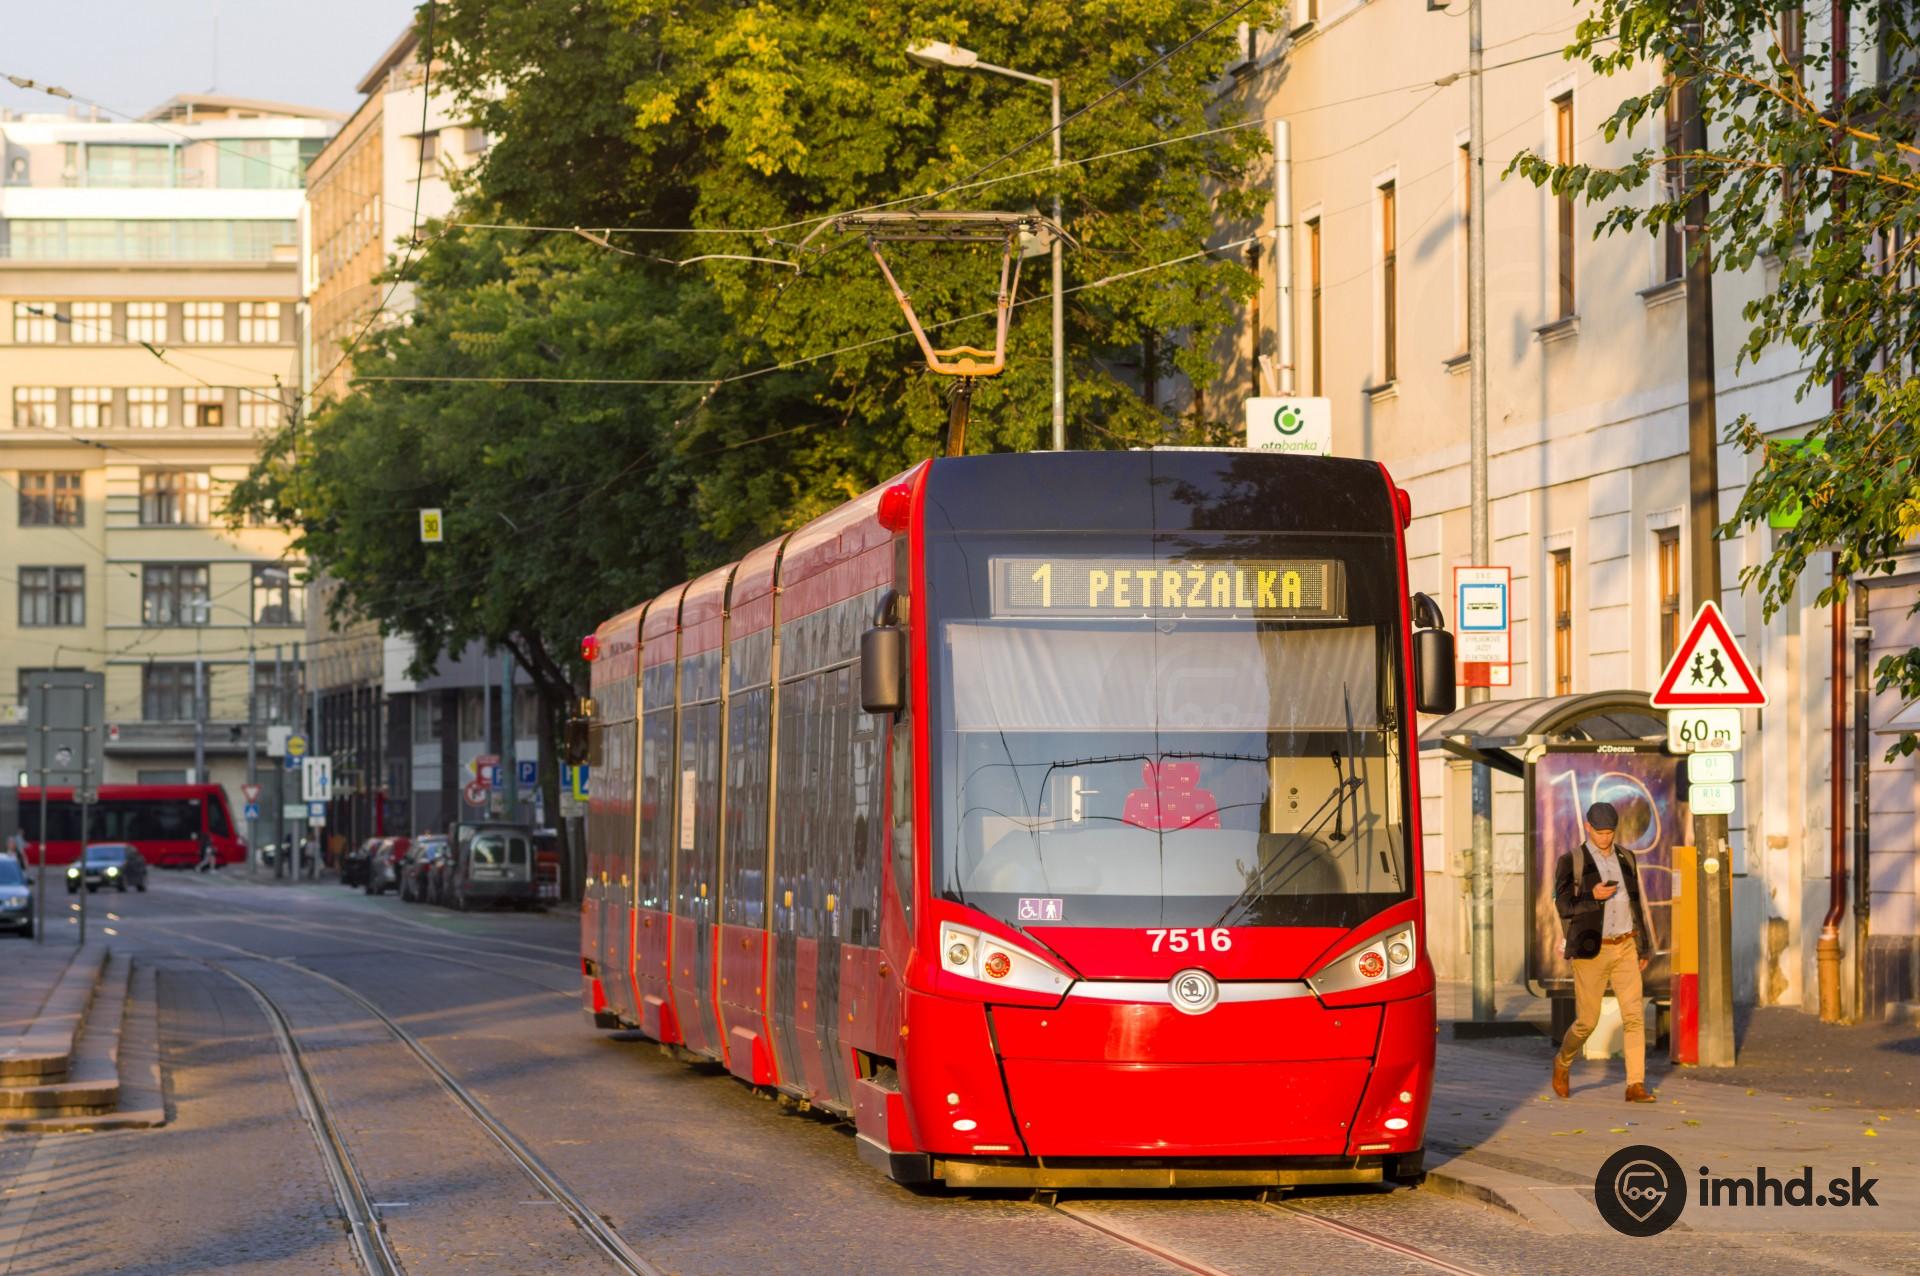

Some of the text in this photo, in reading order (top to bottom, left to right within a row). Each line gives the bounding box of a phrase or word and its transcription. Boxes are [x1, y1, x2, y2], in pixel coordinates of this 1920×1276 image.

[424, 519, 439, 533] 30
[1031, 563, 1302, 608] 1 PETRŽALKA
[1679, 719, 1731, 742] 60 m
[1596, 745, 1635, 753] JCDecaux
[523, 763, 533, 781] P
[1146, 927, 1232, 953] 7516
